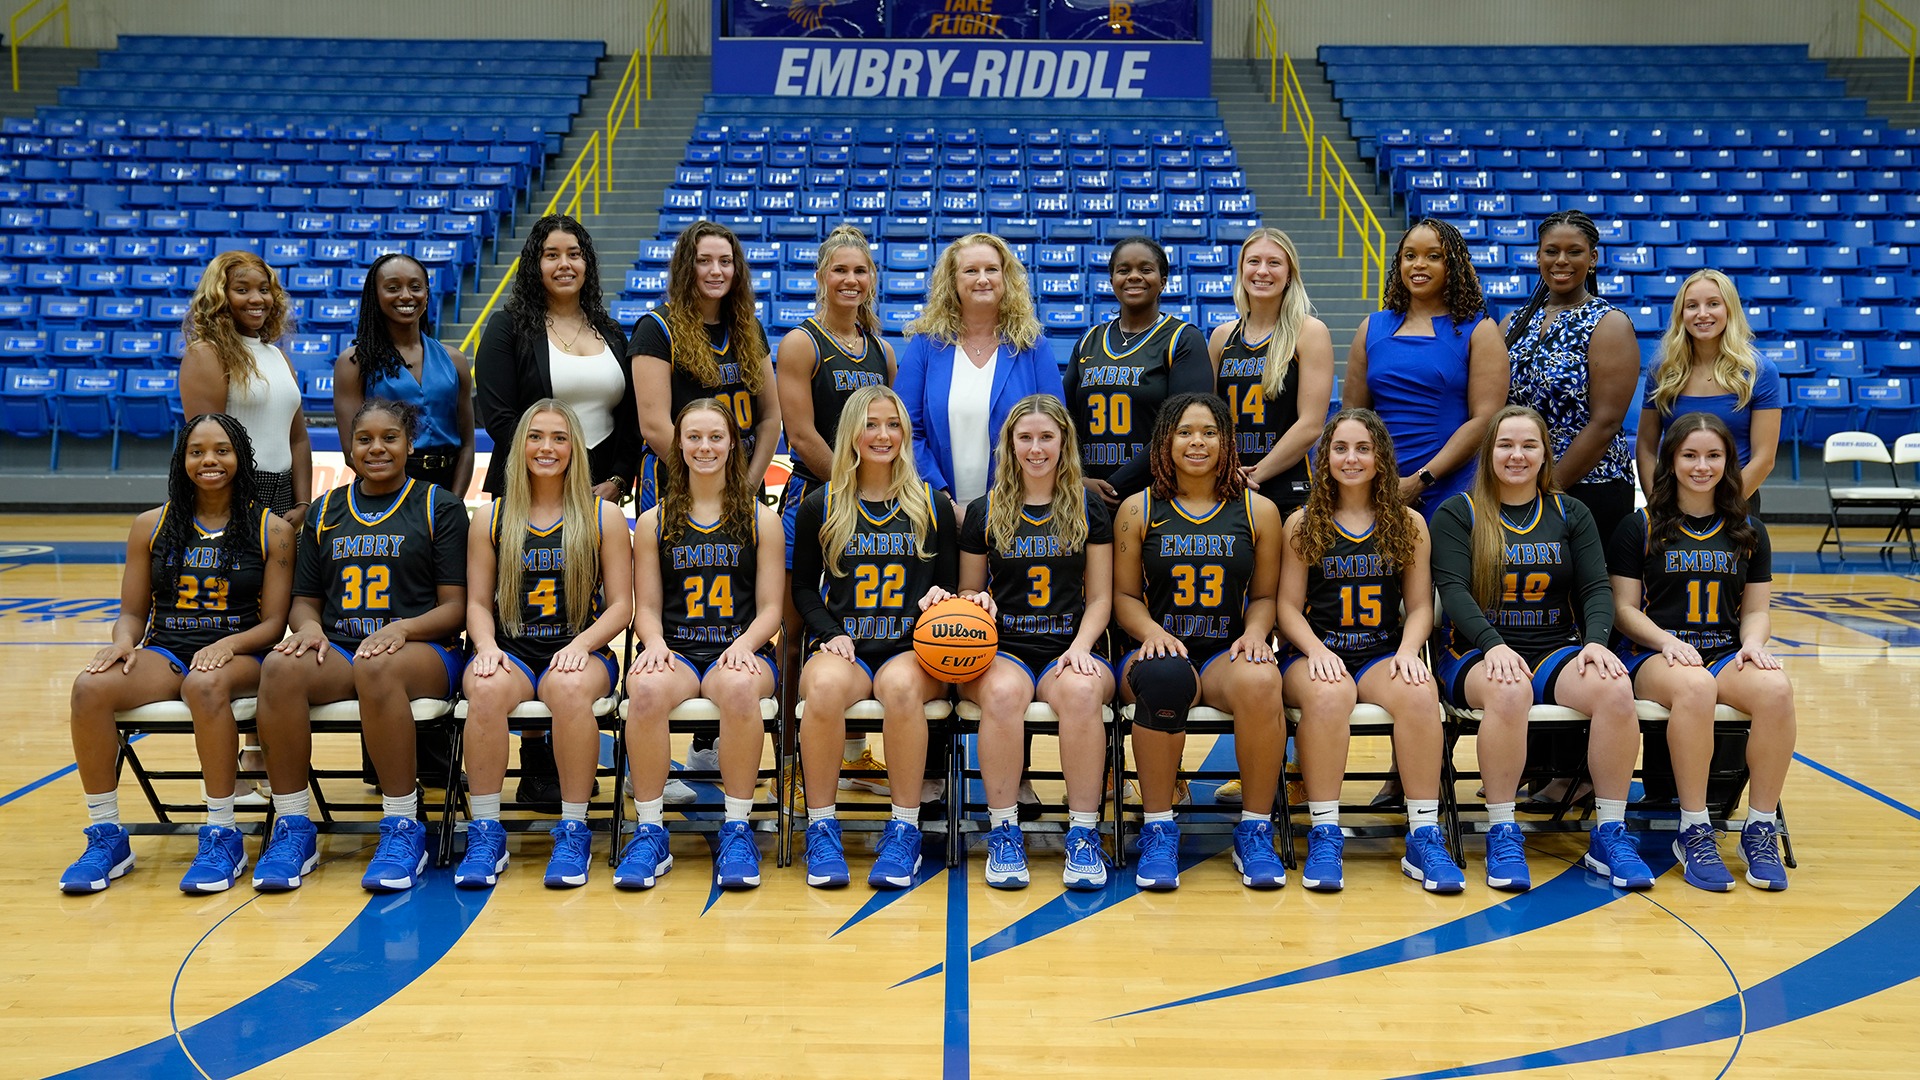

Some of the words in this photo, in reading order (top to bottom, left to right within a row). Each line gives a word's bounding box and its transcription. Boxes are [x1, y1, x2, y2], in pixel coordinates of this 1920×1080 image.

[929, 14, 1003, 35] FLIGHT.
[774, 48, 1150, 98] EMBRY-RIDDLE
[1080, 366, 1145, 387] EMBRY
[1220, 357, 1267, 378] EMBR
[1088, 391, 1132, 436] 30
[1227, 384, 1266, 425] 14
[1083, 443, 1144, 465] RIDDLE
[332, 534, 405, 560] EMBRY
[521, 548, 567, 571] MBR
[672, 543, 742, 570] EMBRY
[1160, 534, 1236, 557] EMBRY
[1501, 542, 1562, 565] MBRY
[175, 573, 231, 612] 23
[341, 563, 391, 611] 32
[526, 577, 558, 618] 4
[682, 573, 735, 620] 24
[854, 563, 907, 610] 22
[1026, 563, 1053, 609] 3
[1170, 563, 1227, 609] 33
[1685, 578, 1722, 625] 11
[1338, 583, 1383, 629] 15
[931, 622, 988, 641] Wilson
[1002, 613, 1074, 635] RIDDLE
[1163, 613, 1230, 638] RIDDLE
